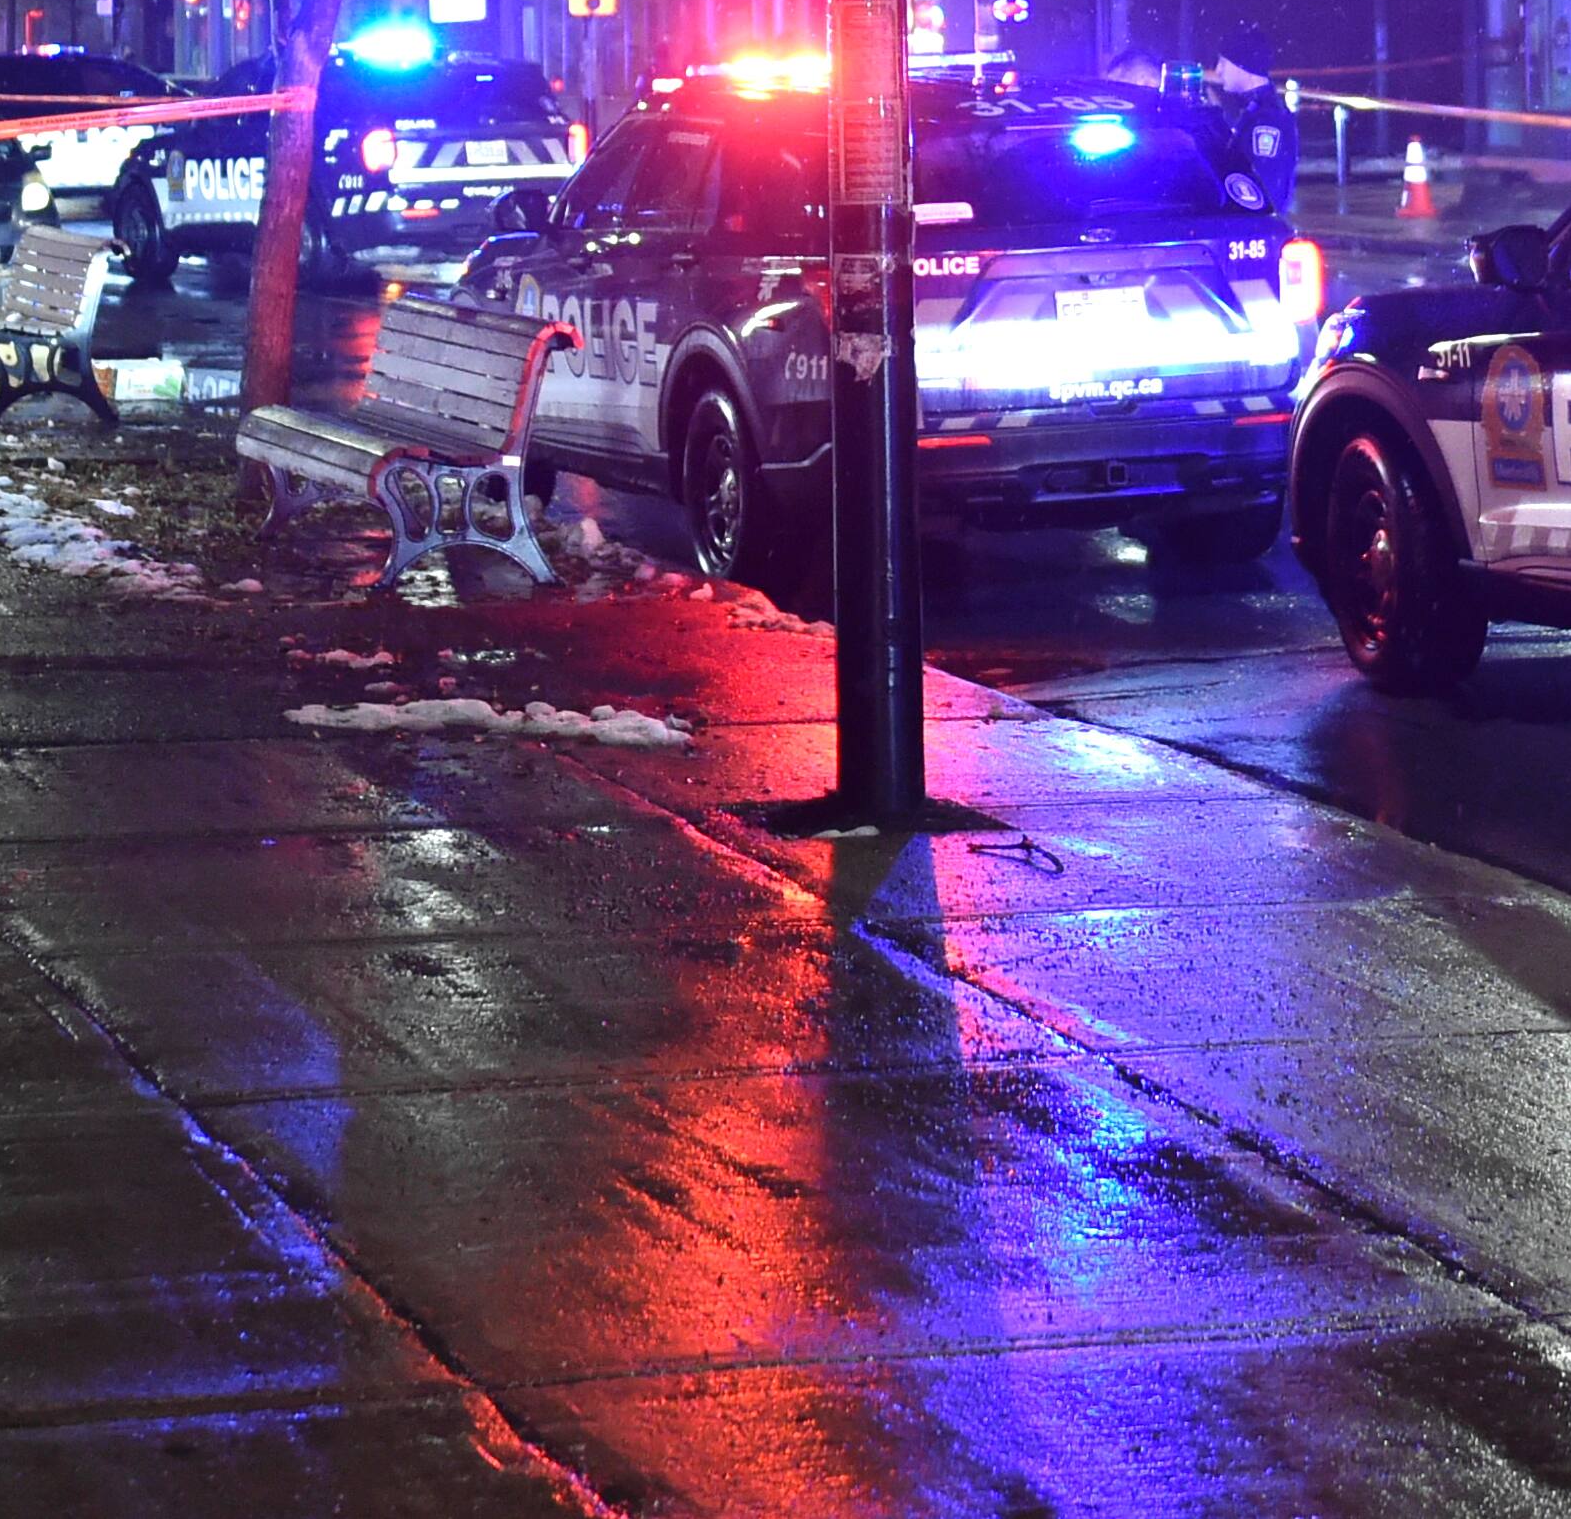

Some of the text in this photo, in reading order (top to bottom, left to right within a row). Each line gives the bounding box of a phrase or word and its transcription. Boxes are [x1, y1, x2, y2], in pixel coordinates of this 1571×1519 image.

[185, 157, 265, 201] POLICE
[1228, 239, 1267, 261] 31-85
[912, 255, 981, 277] OLICE
[795, 353, 828, 380] 911
[1049, 377, 1164, 402] spvm.qc.ca
